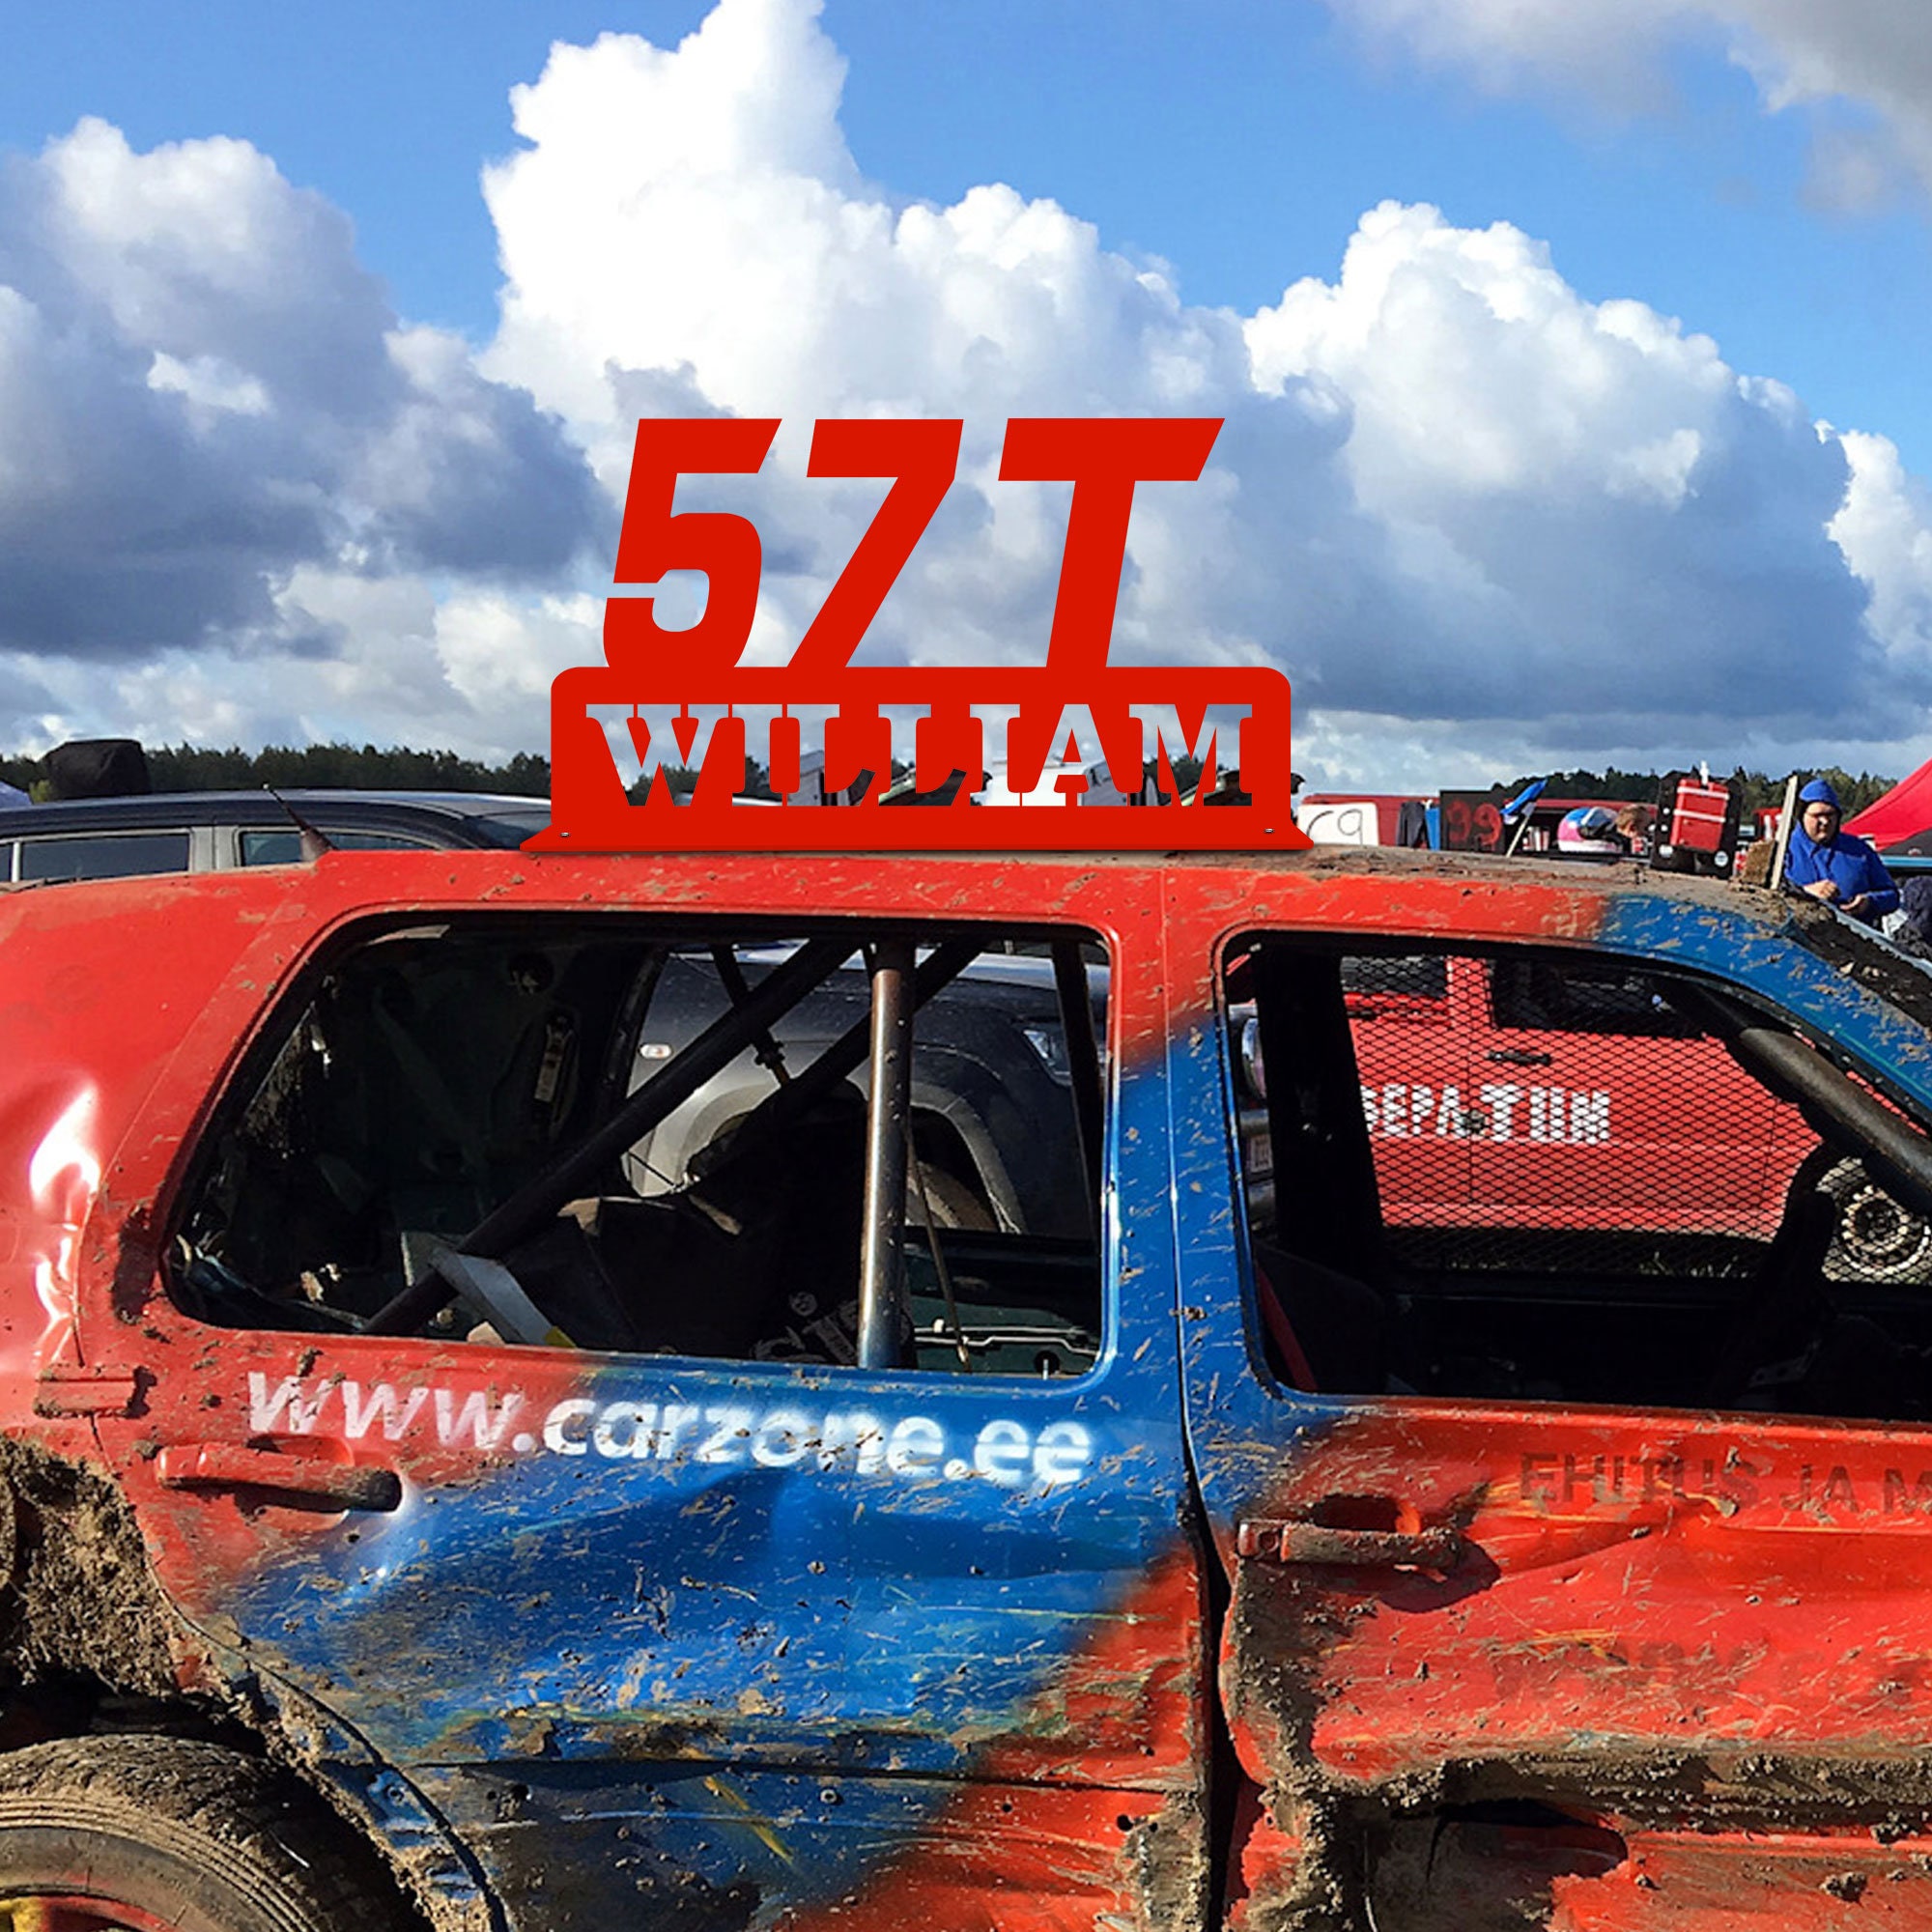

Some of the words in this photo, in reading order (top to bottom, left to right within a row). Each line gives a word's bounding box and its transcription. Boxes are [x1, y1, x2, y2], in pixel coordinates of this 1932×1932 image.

[603, 418, 1225, 668] 57T
[585, 704, 1253, 807] WILLIAM
[247, 1372, 1091, 1485] www.carzone.ee
